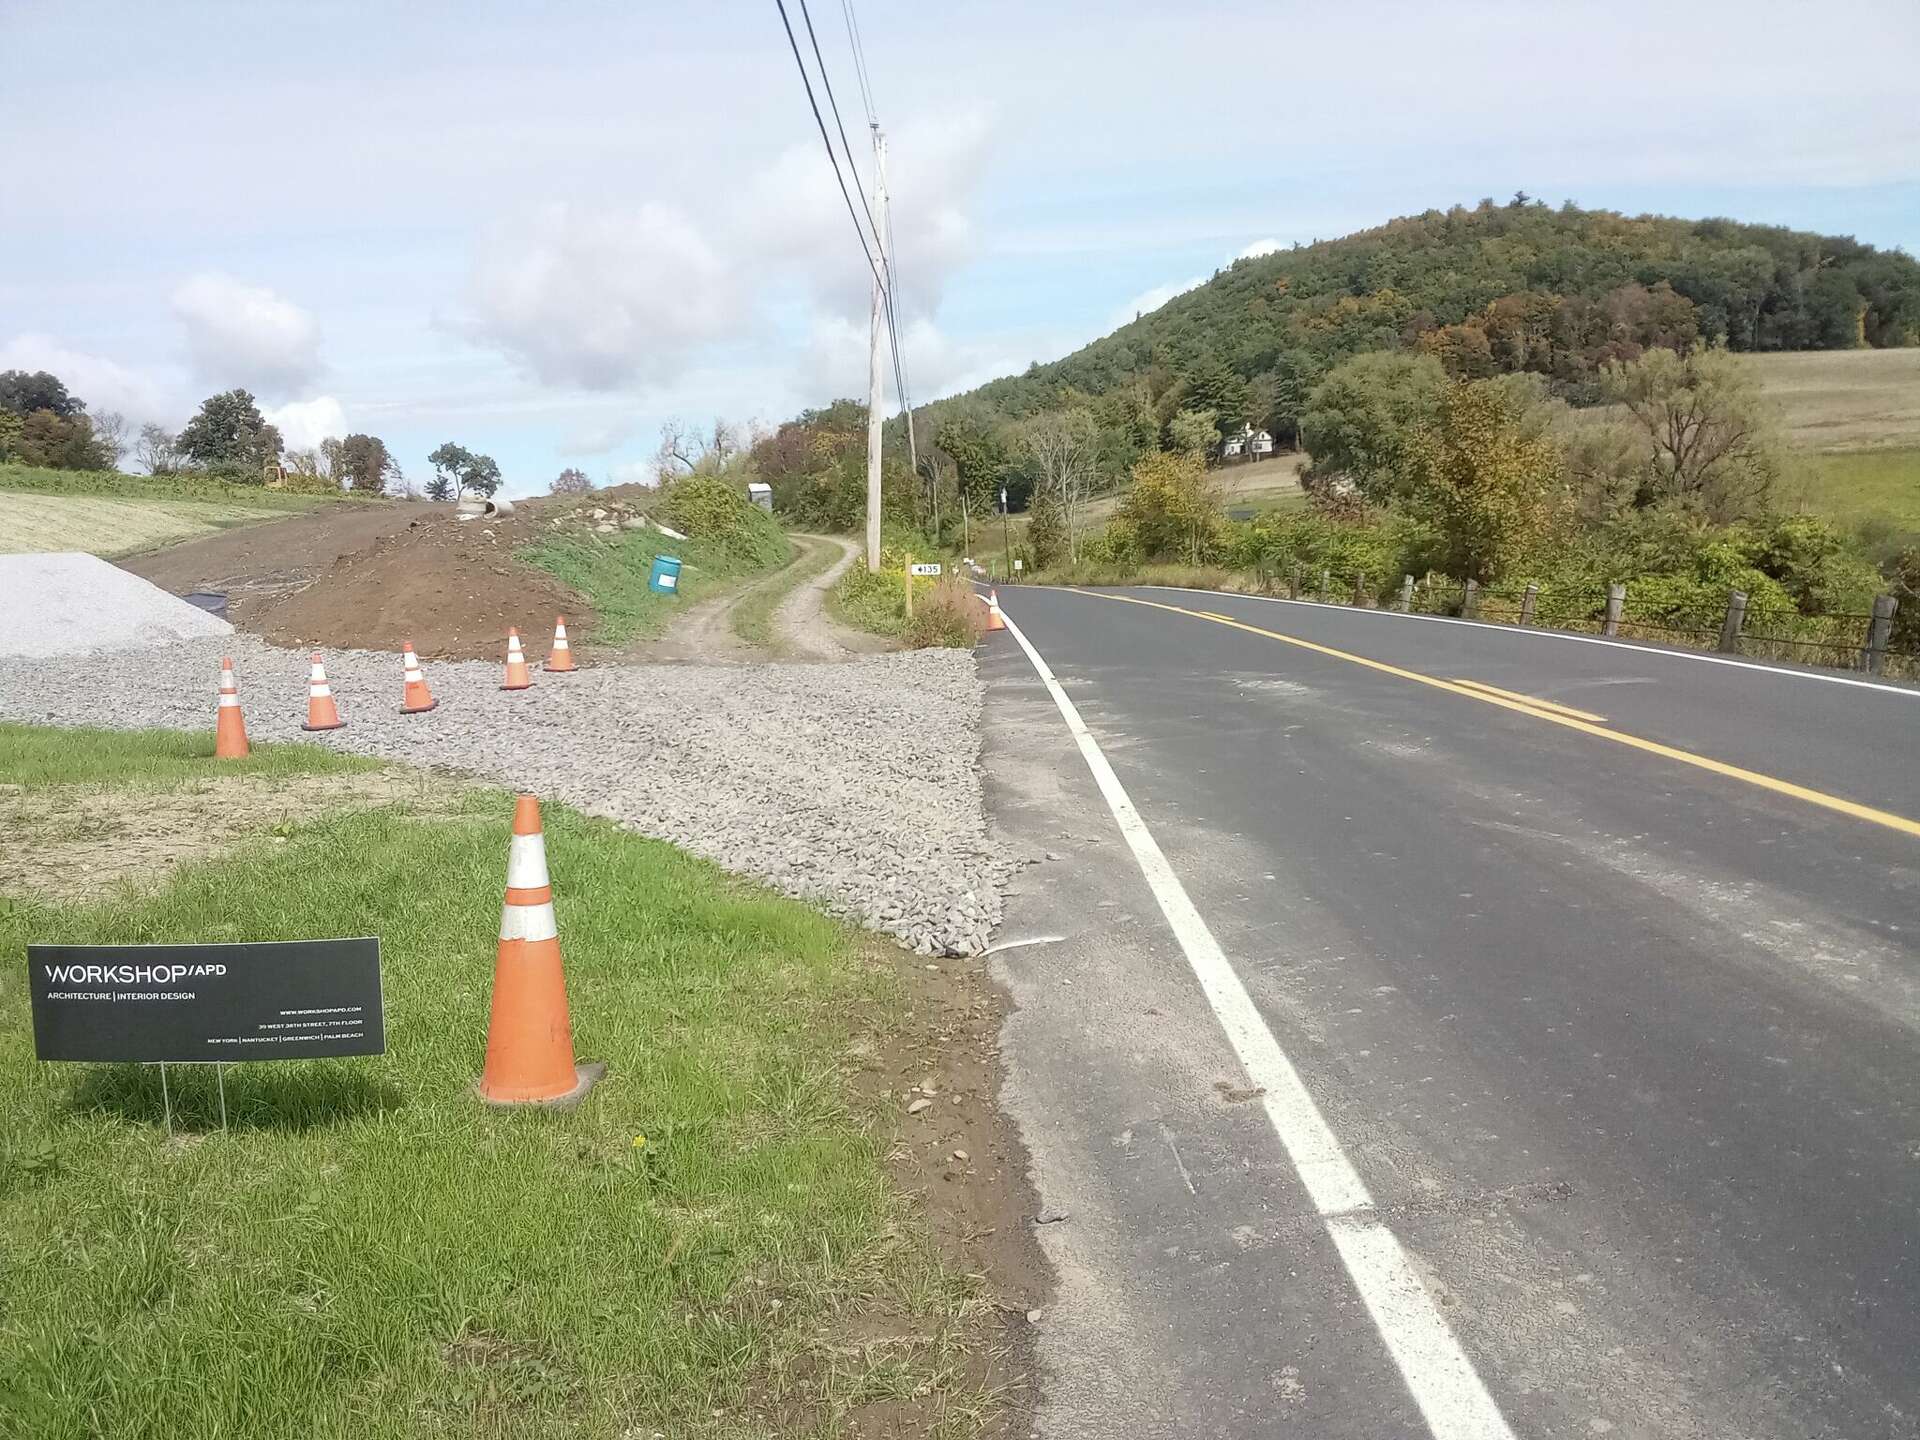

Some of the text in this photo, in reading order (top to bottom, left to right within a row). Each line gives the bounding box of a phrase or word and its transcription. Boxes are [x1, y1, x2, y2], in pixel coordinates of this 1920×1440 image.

[47, 992, 195, 1000] ARCHITECTURE INTERIOR DESIGN
